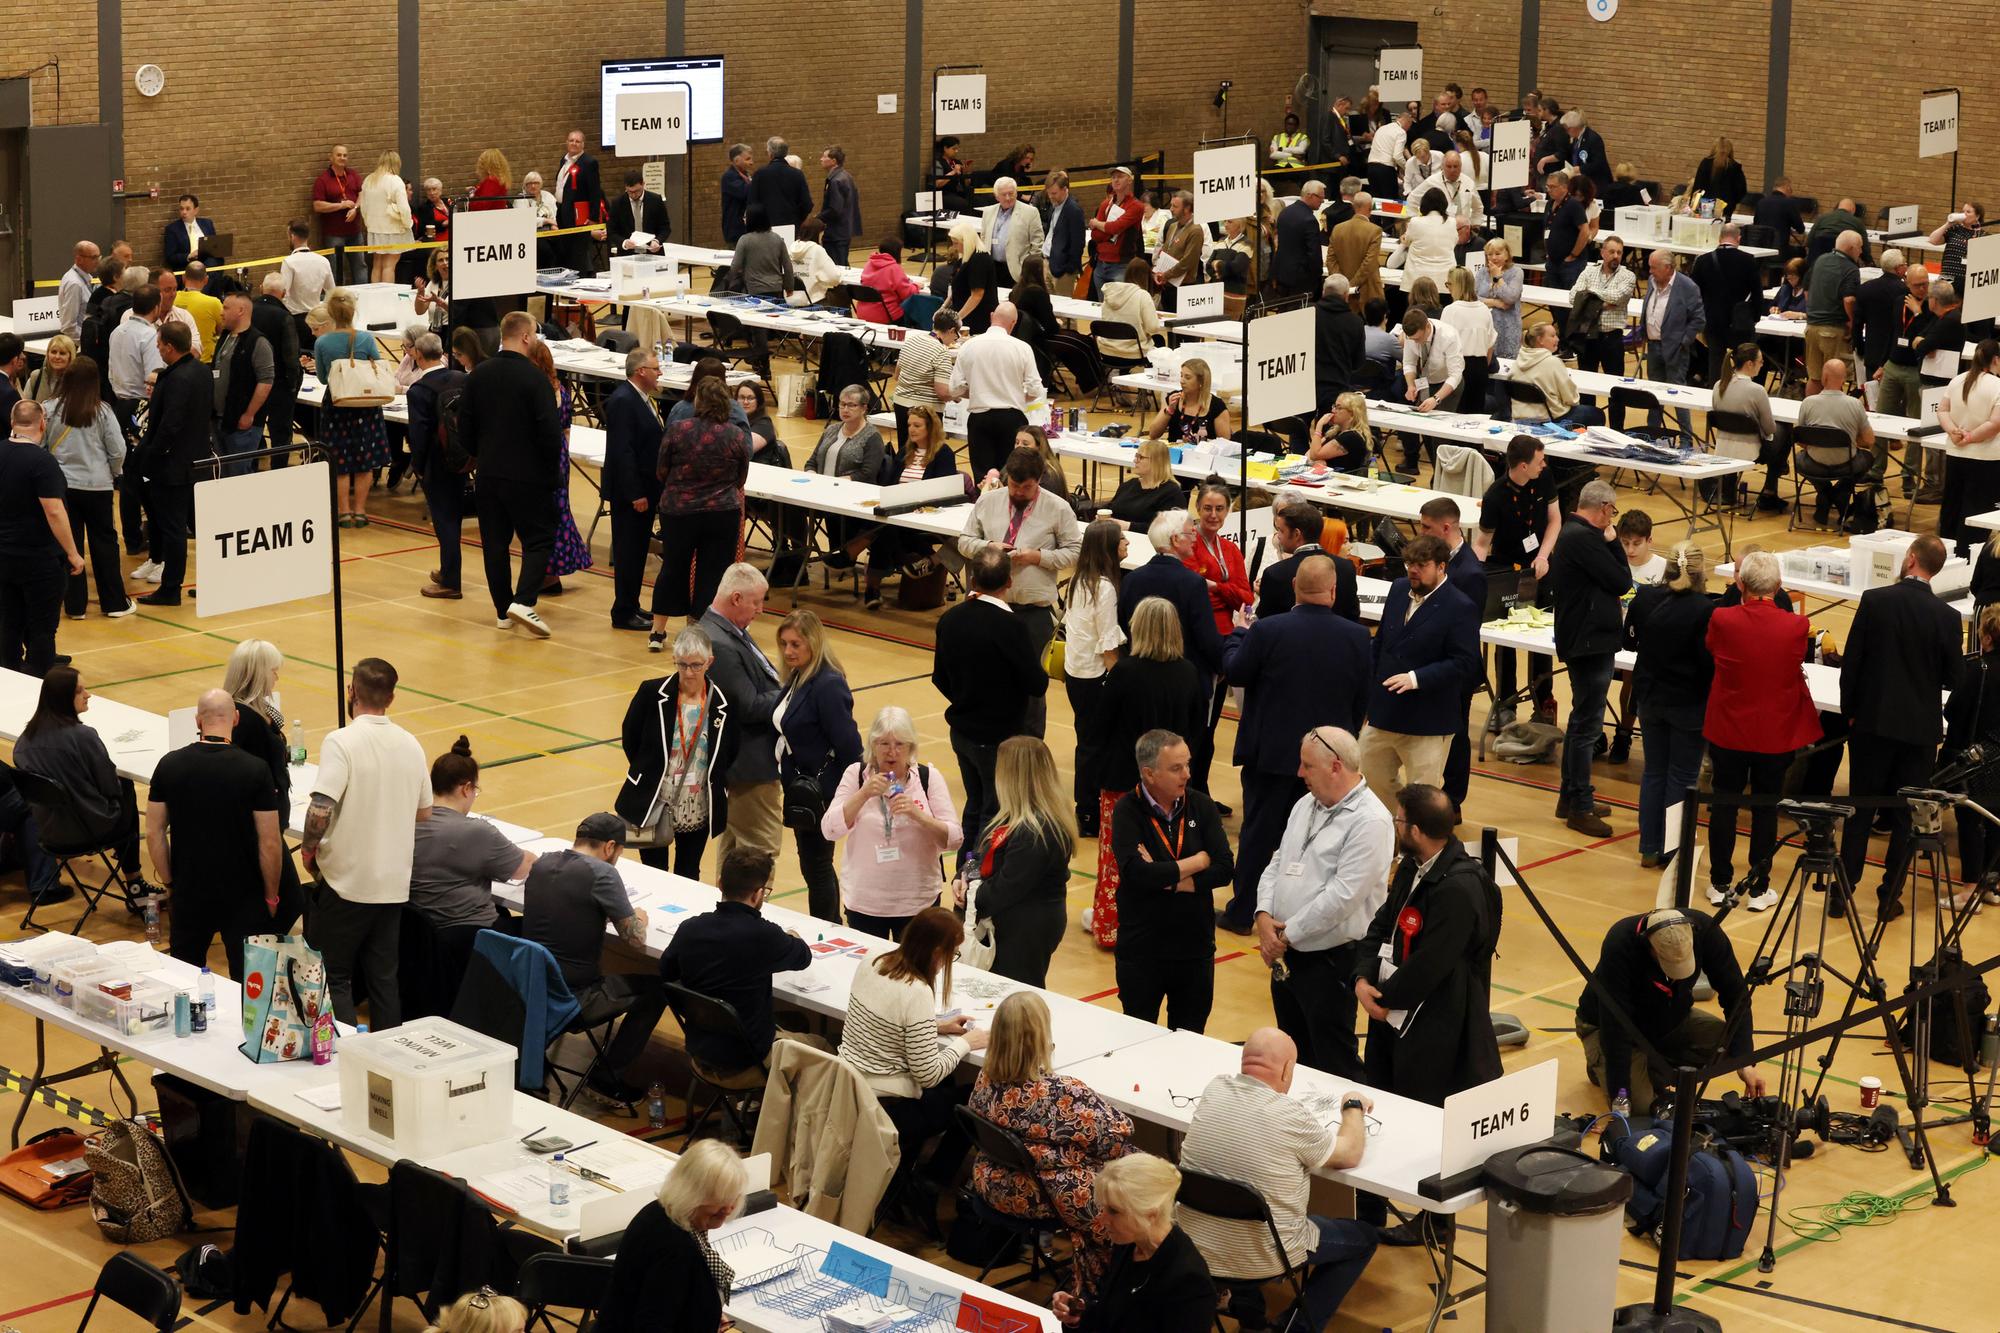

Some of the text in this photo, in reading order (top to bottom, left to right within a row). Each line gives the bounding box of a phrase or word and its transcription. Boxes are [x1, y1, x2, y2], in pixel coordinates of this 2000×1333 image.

[1383, 70, 1418, 80] TEAM 16
[941, 98, 981, 111] TEAM 15
[621, 116, 680, 131] TEAM 10
[1923, 118, 1955, 134] TEAM 17
[1492, 147, 1526, 163] TEAM 14
[1200, 174, 1250, 194] TEAM 11
[464, 242, 526, 263] TEAM 8
[1970, 268, 1999, 289] TEAM
[1187, 296, 1214, 307] TEAM 11
[28, 311, 53, 321] TEAM
[1258, 351, 1307, 381] TEAM 7
[215, 518, 314, 558] TEAM 6
[1251, 529, 1257, 541] 7
[1501, 593, 1519, 602] BALLOT
[394, 1037, 441, 1058] MIXING
[424, 1034, 457, 1050] WELL
[370, 1091, 391, 1107] MIXING
[373, 1106, 388, 1120] WELL
[1471, 1102, 1530, 1140] TEAM 6
